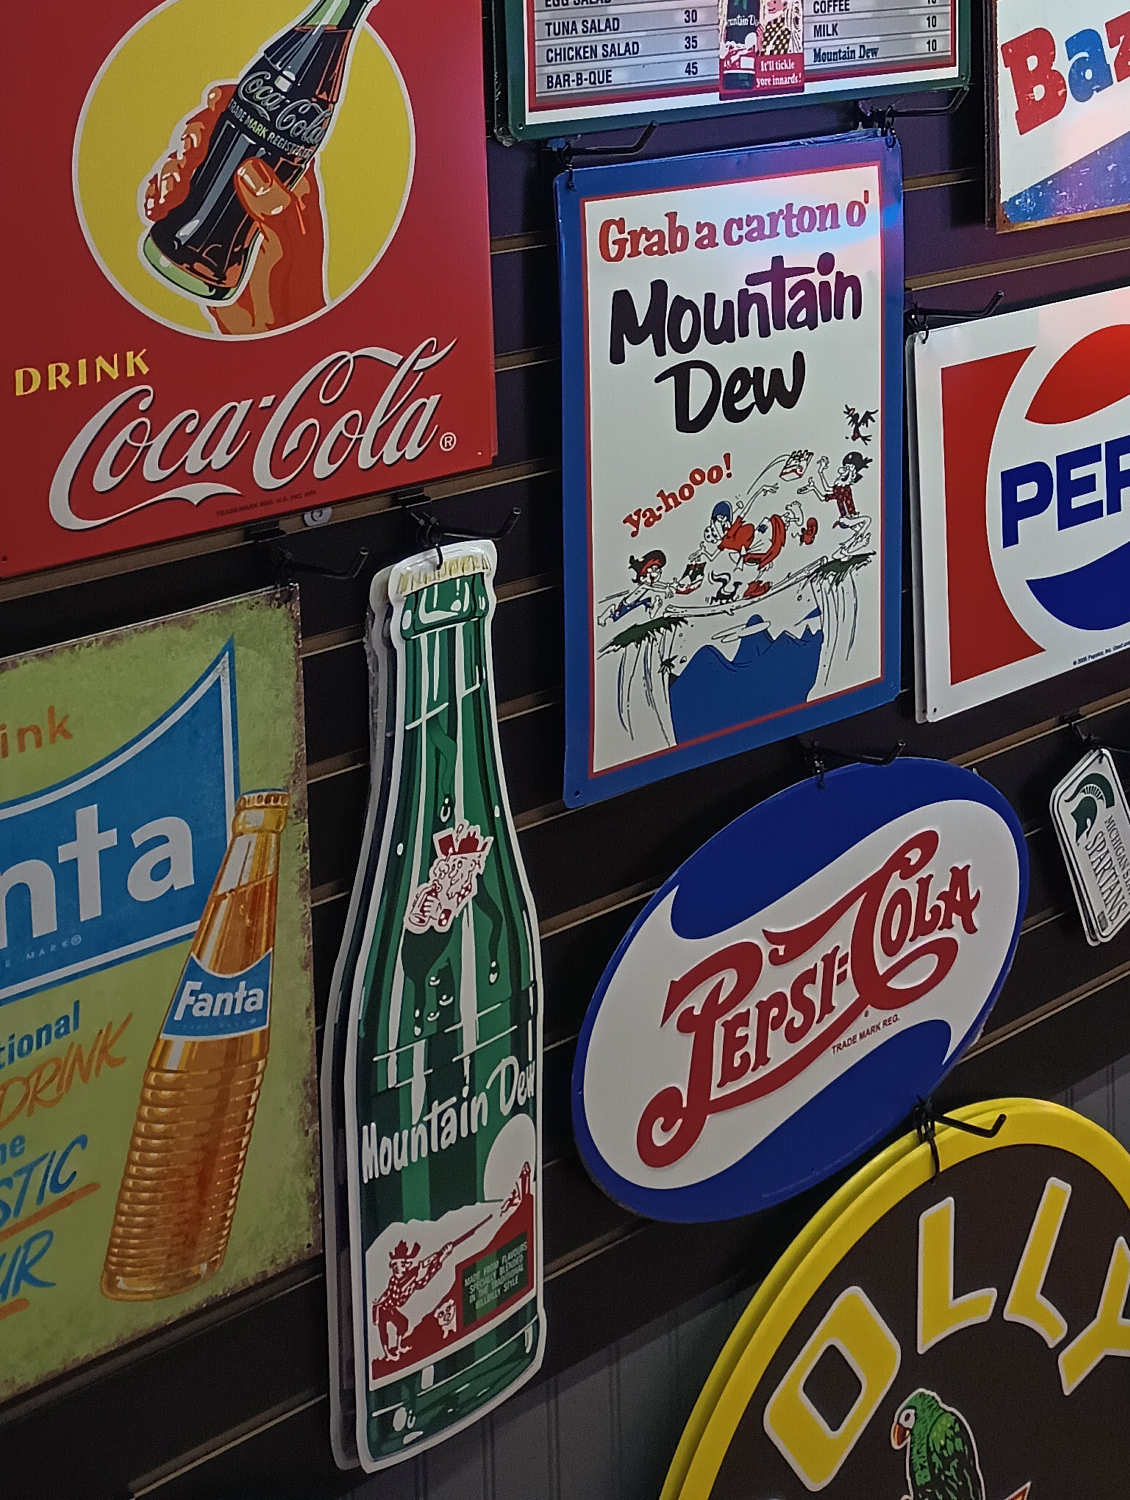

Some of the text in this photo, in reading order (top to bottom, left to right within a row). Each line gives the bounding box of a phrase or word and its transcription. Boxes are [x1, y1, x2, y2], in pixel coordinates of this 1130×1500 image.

[545, 17, 620, 37] TUNA SALAD
[546, 69, 613, 89] BAR-B-QUE
[597, 211, 690, 263] Grab
[695, 223, 718, 251] a
[722, 199, 840, 248] carton
[608, 251, 864, 367] Mountain
[14, 347, 151, 397] DRINK
[653, 350, 806, 435] Dew
[48, 336, 459, 531] Coca-Cola
[1103, 814, 1129, 871] MICHIGAN
[1084, 830, 1129, 923] SPARTANS
[173, 980, 265, 1022] Fanta
[361, 1055, 536, 1184] Mountain Dew
